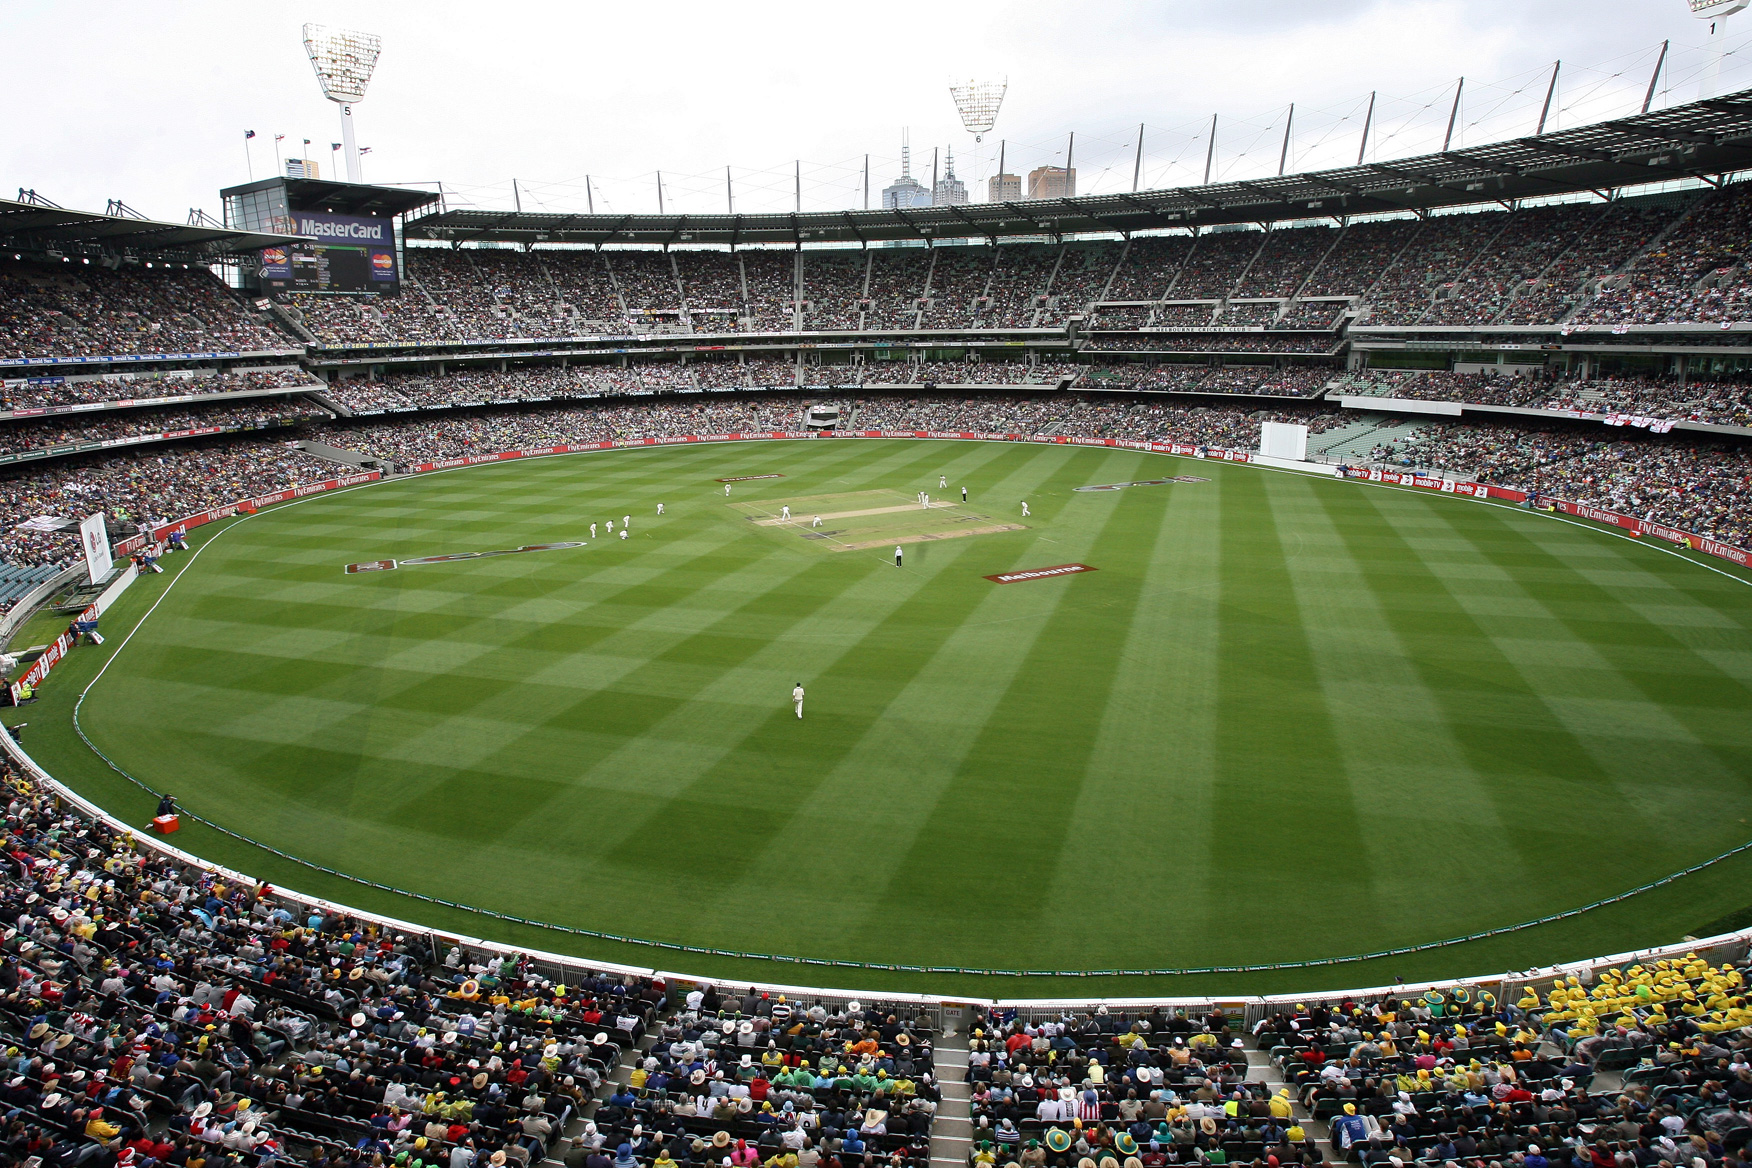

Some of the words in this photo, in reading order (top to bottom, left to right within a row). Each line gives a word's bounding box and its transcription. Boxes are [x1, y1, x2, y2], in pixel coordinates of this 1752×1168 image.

[1710, 22, 1715, 35] 1
[345, 106, 351, 116] 5
[302, 219, 381, 239] MasterCard
[433, 460, 442, 469] Fly
[442, 459, 464, 467] Emirates
[338, 479, 347, 488] Fly
[347, 475, 369, 486] Emirates
[1415, 479, 1441, 488] mobileTV
[294, 488, 303, 497] Fly
[303, 483, 326, 495] Emirates
[252, 499, 261, 508] Fly
[261, 493, 283, 506] Emirates
[208, 511, 217, 521] Fly
[1577, 505, 1588, 518] Fly
[1588, 508, 1619, 524] Emirates
[1638, 520, 1651, 534] Fly
[1652, 524, 1682, 541] Emirates
[1701, 539, 1714, 554] Fly
[1714, 543, 1747, 563] Emirates
[702, 1100, 708, 1111] 4
